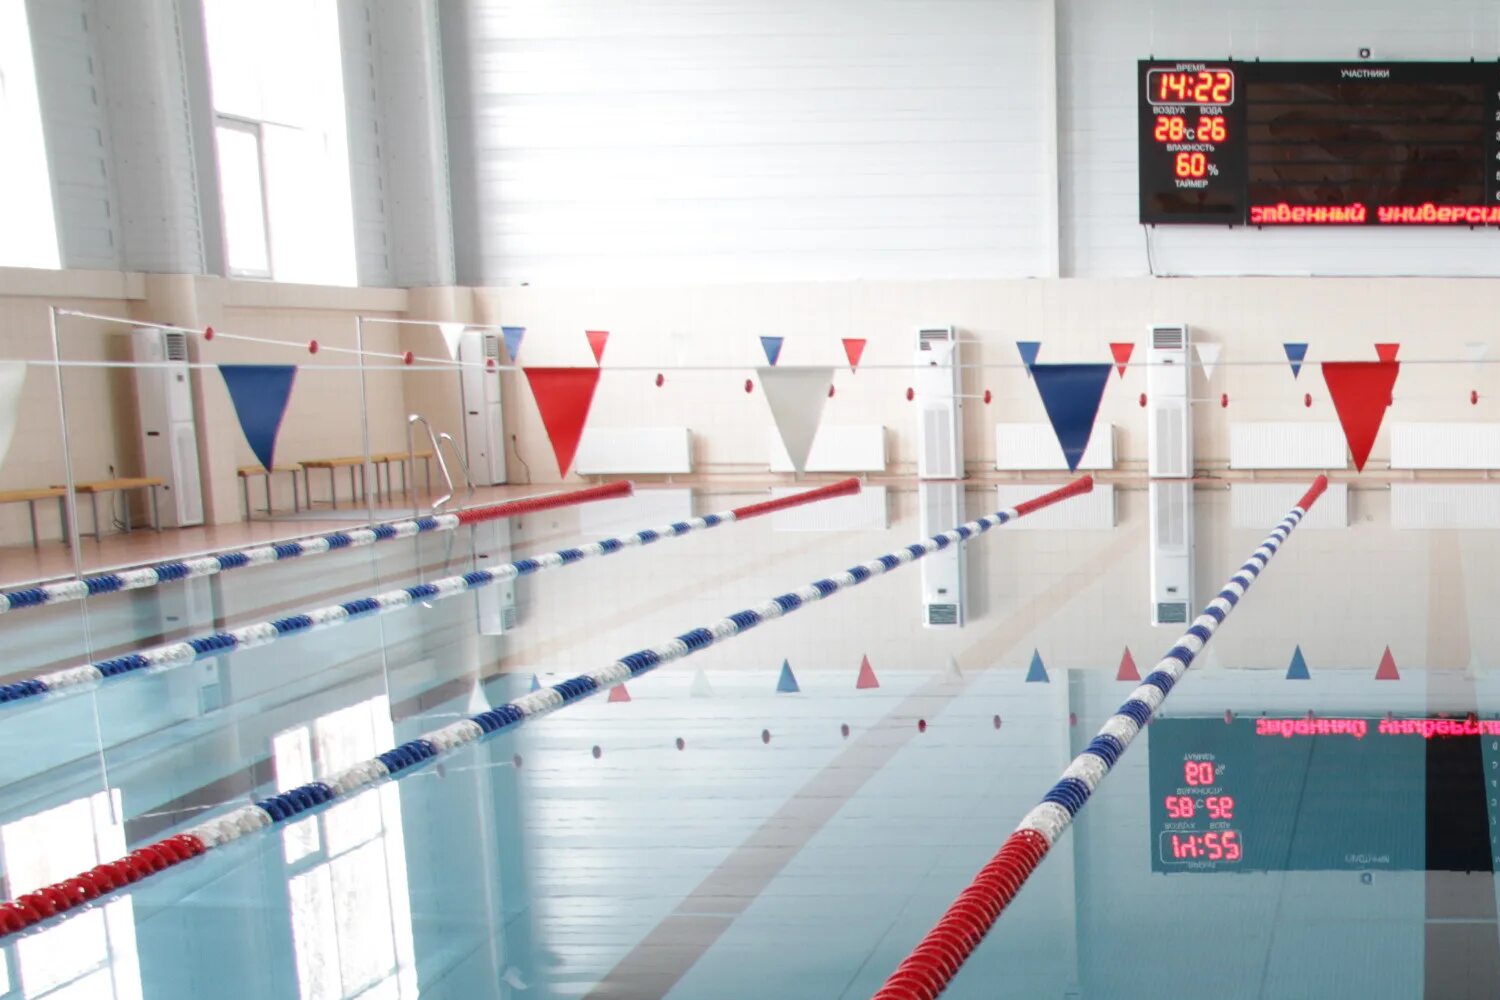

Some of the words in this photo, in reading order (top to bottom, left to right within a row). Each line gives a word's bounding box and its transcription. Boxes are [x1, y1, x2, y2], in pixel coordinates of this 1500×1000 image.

[1176, 63, 1206, 72] ВРЕМЯ
[1341, 69, 1390, 78] УЧАСТНИКИ
[1160, 71, 1231, 102] 14:22
[1153, 106, 1186, 115] ВОЗДУХ
[1200, 106, 1223, 115] ВОДА
[1154, 115, 1184, 141] 28
[1197, 115, 1226, 141] 26
[1166, 143, 1215, 152] ВЛАЖНОСТЬ
[1175, 152, 1206, 177] 60
[1207, 164, 1219, 176] %
[1175, 179, 1208, 188] ТАЙМЕР
